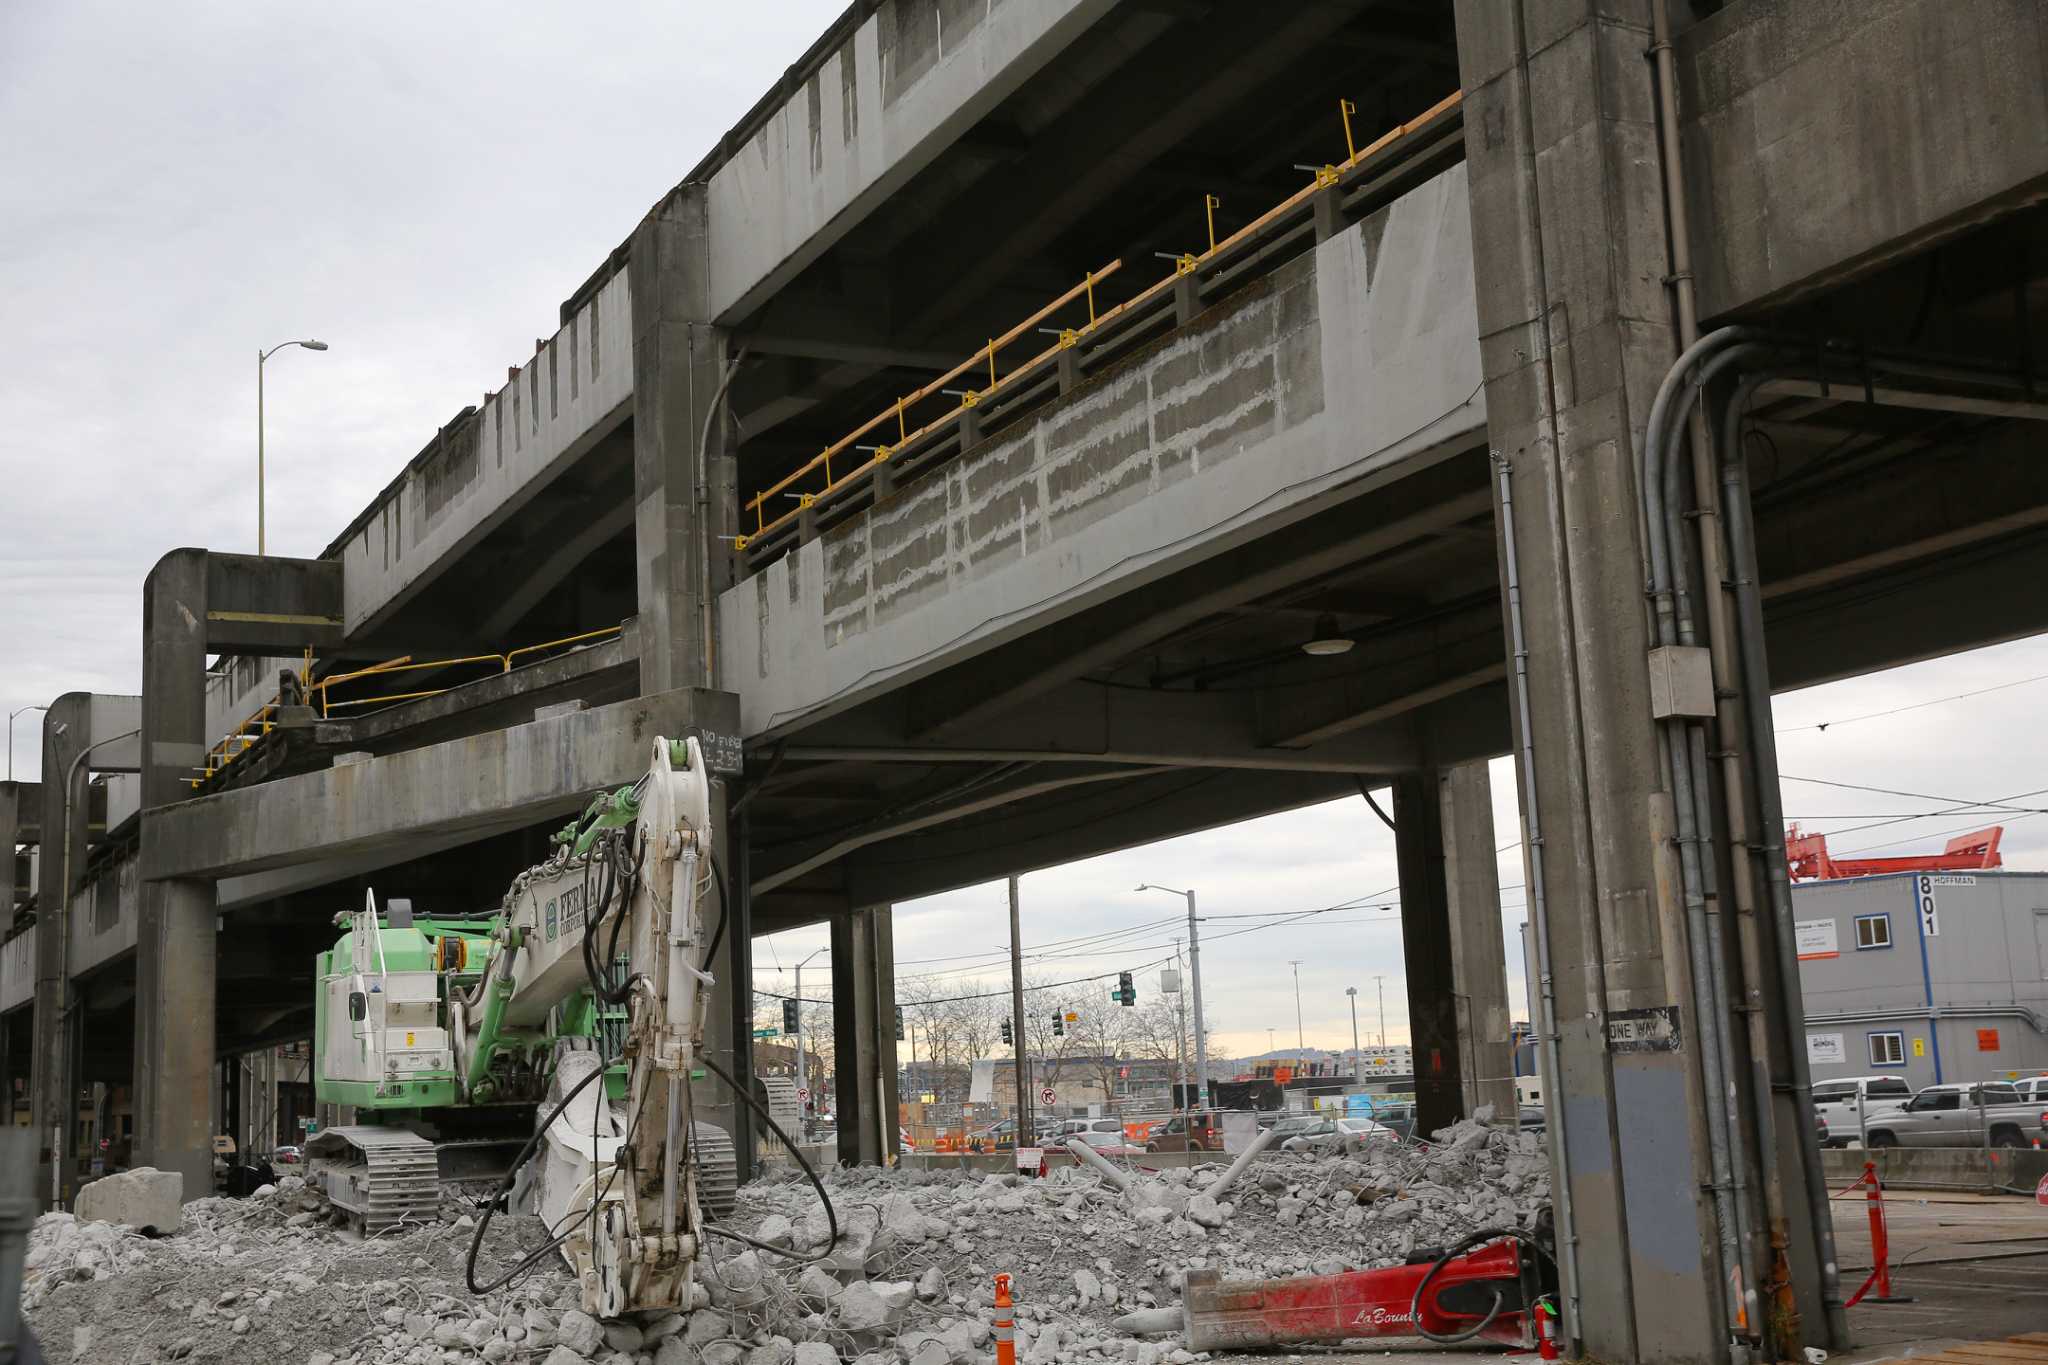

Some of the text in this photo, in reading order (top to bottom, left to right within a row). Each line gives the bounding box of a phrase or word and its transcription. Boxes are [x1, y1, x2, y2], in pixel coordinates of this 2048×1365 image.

[1920, 876, 1934, 935] 801
[1610, 1020, 1657, 1039] ONE WAY
